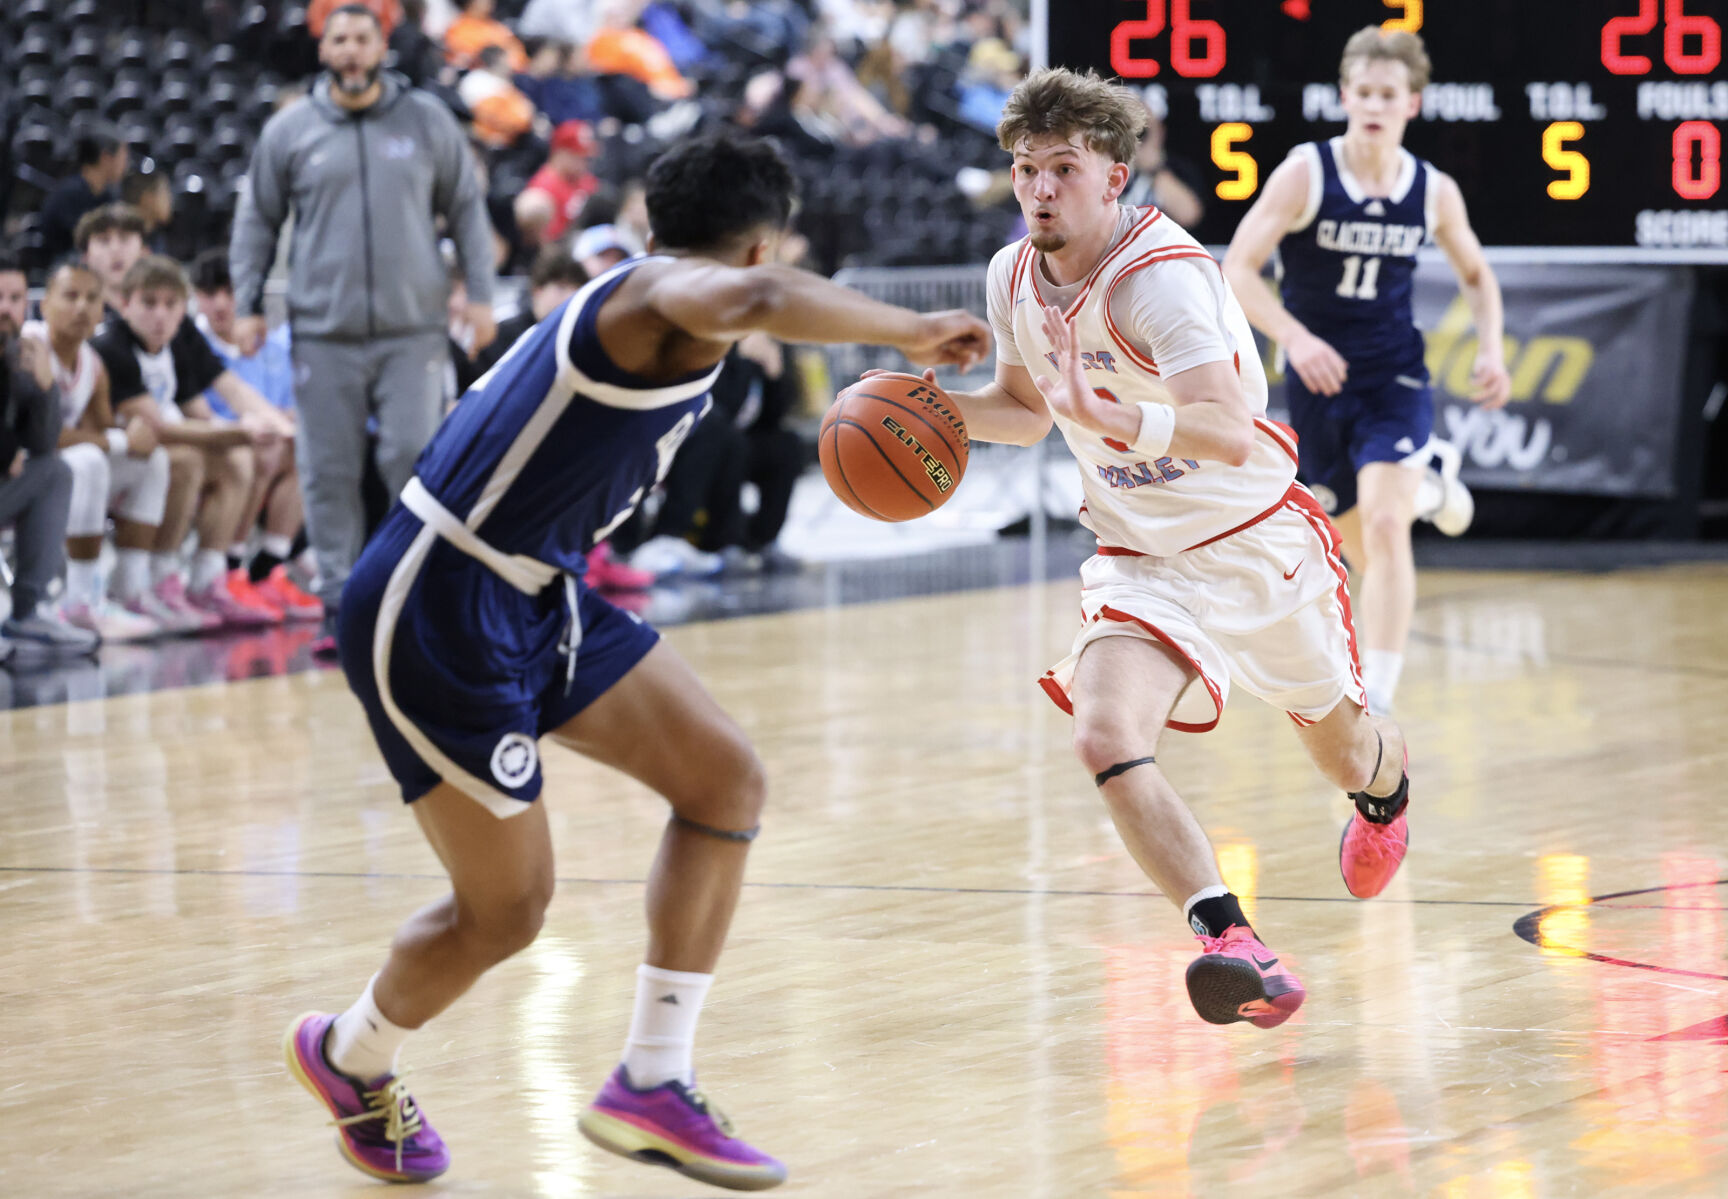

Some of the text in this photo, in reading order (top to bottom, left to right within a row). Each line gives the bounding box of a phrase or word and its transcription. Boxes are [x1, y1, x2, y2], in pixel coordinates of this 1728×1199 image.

[1110, 0, 1226, 78] 26
[1601, 0, 1722, 75] 26
[1211, 122, 1258, 200] 5
[1542, 121, 1590, 200] 5
[1672, 121, 1721, 199] 0
[1335, 256, 1381, 299] 11
